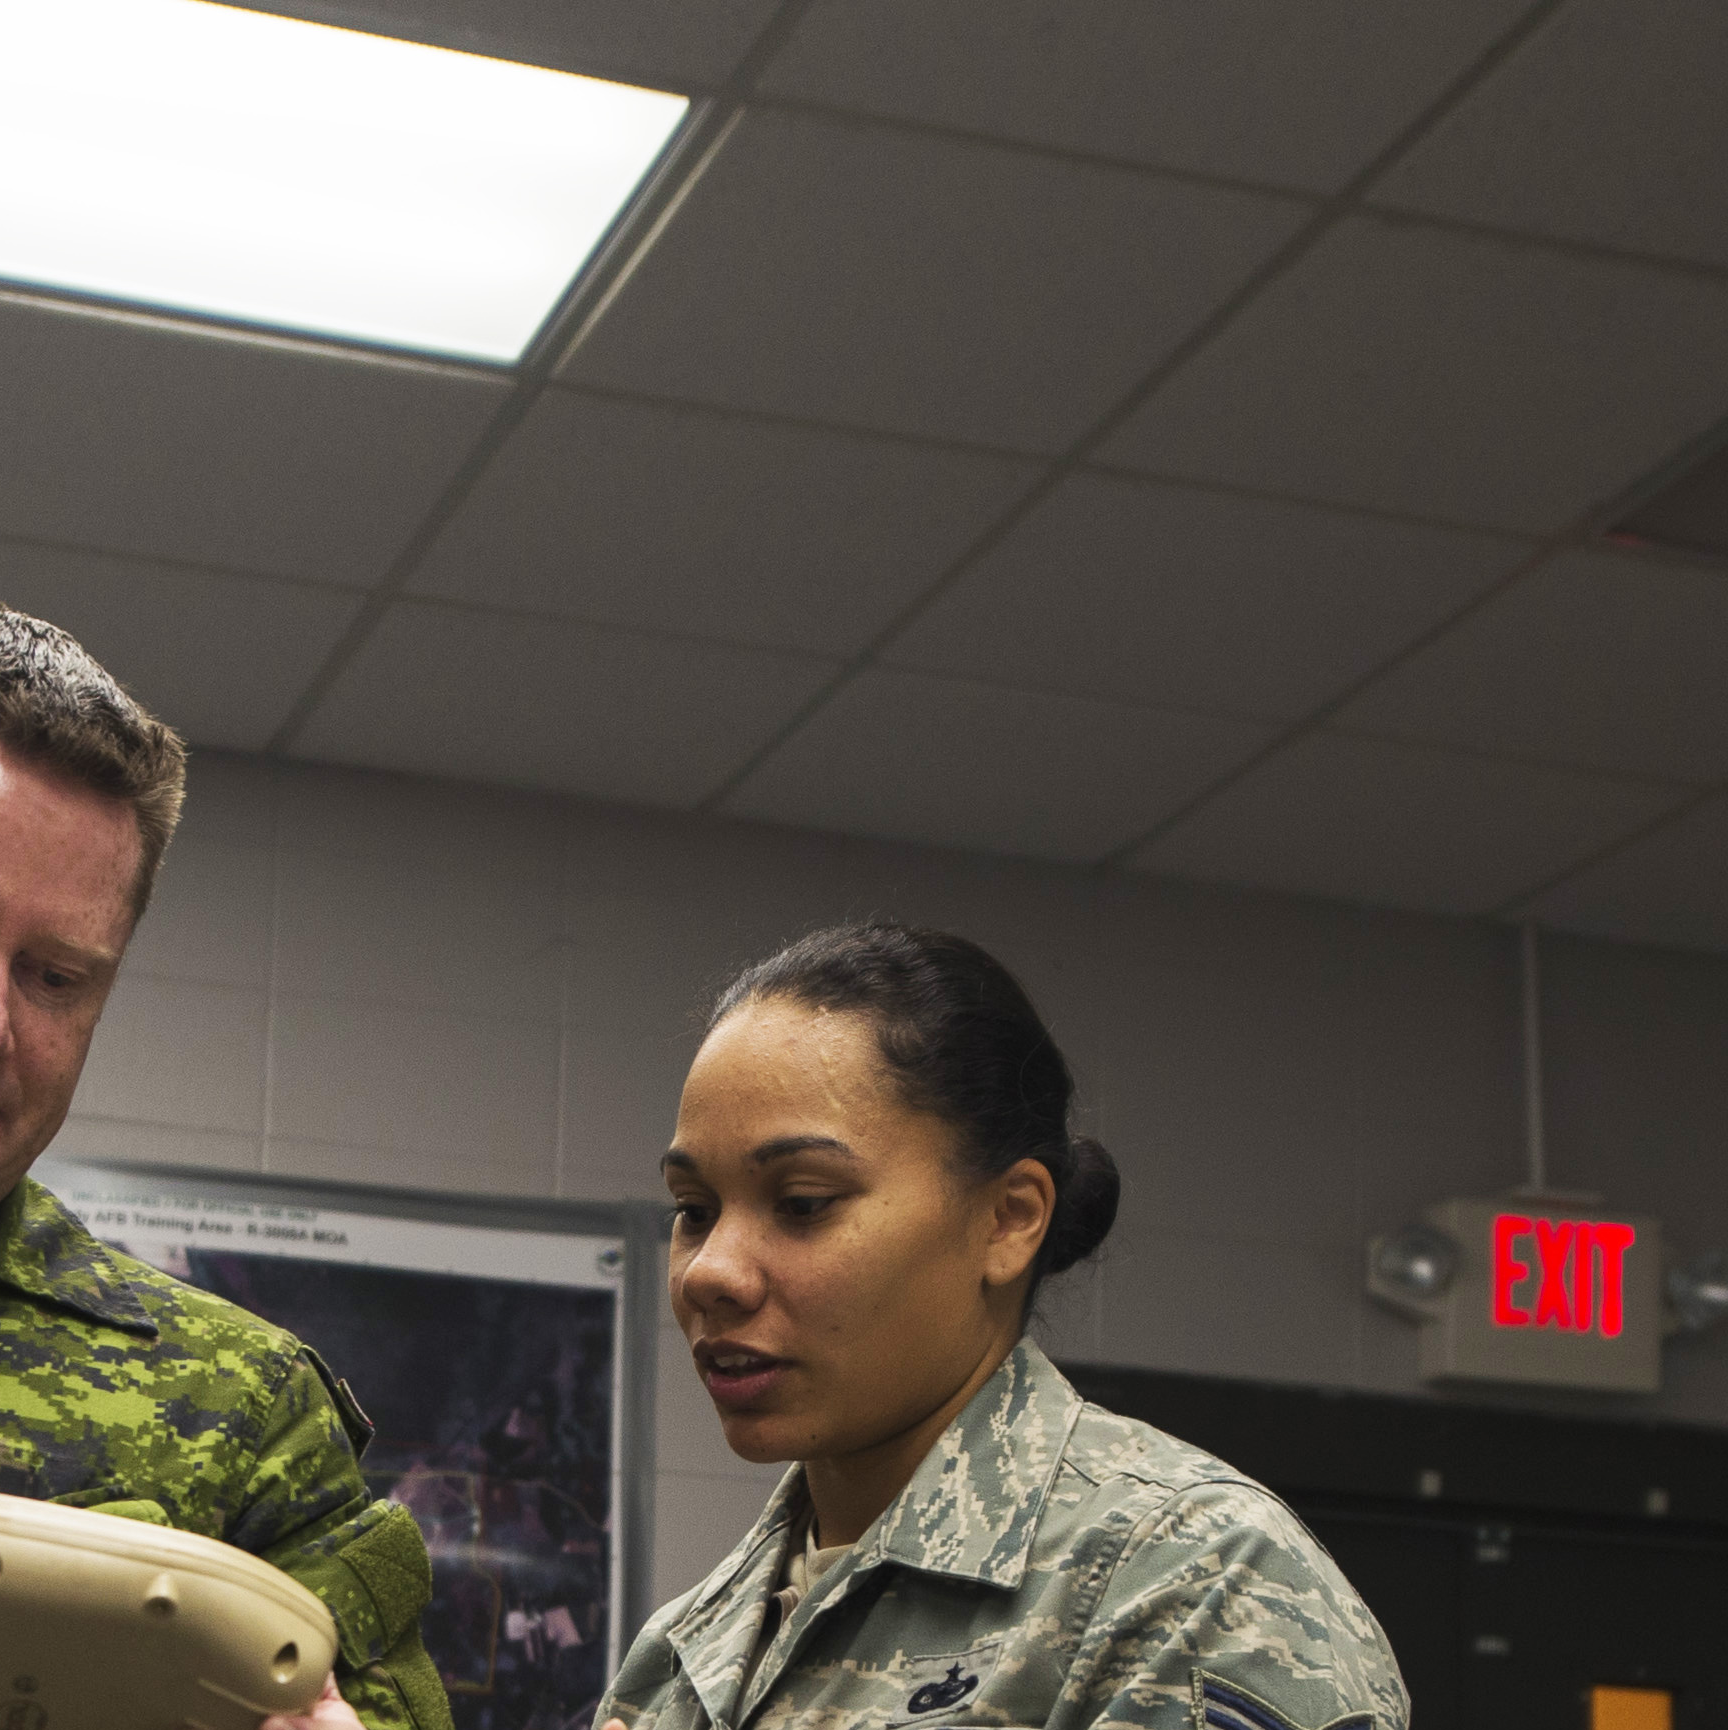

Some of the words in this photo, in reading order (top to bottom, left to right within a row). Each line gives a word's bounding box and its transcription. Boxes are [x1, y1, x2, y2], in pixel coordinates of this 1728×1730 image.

[95, 1210, 127, 1225] AFB
[132, 1212, 194, 1233] Training
[198, 1217, 233, 1234] Area
[1494, 1214, 1635, 1338] EXIT
